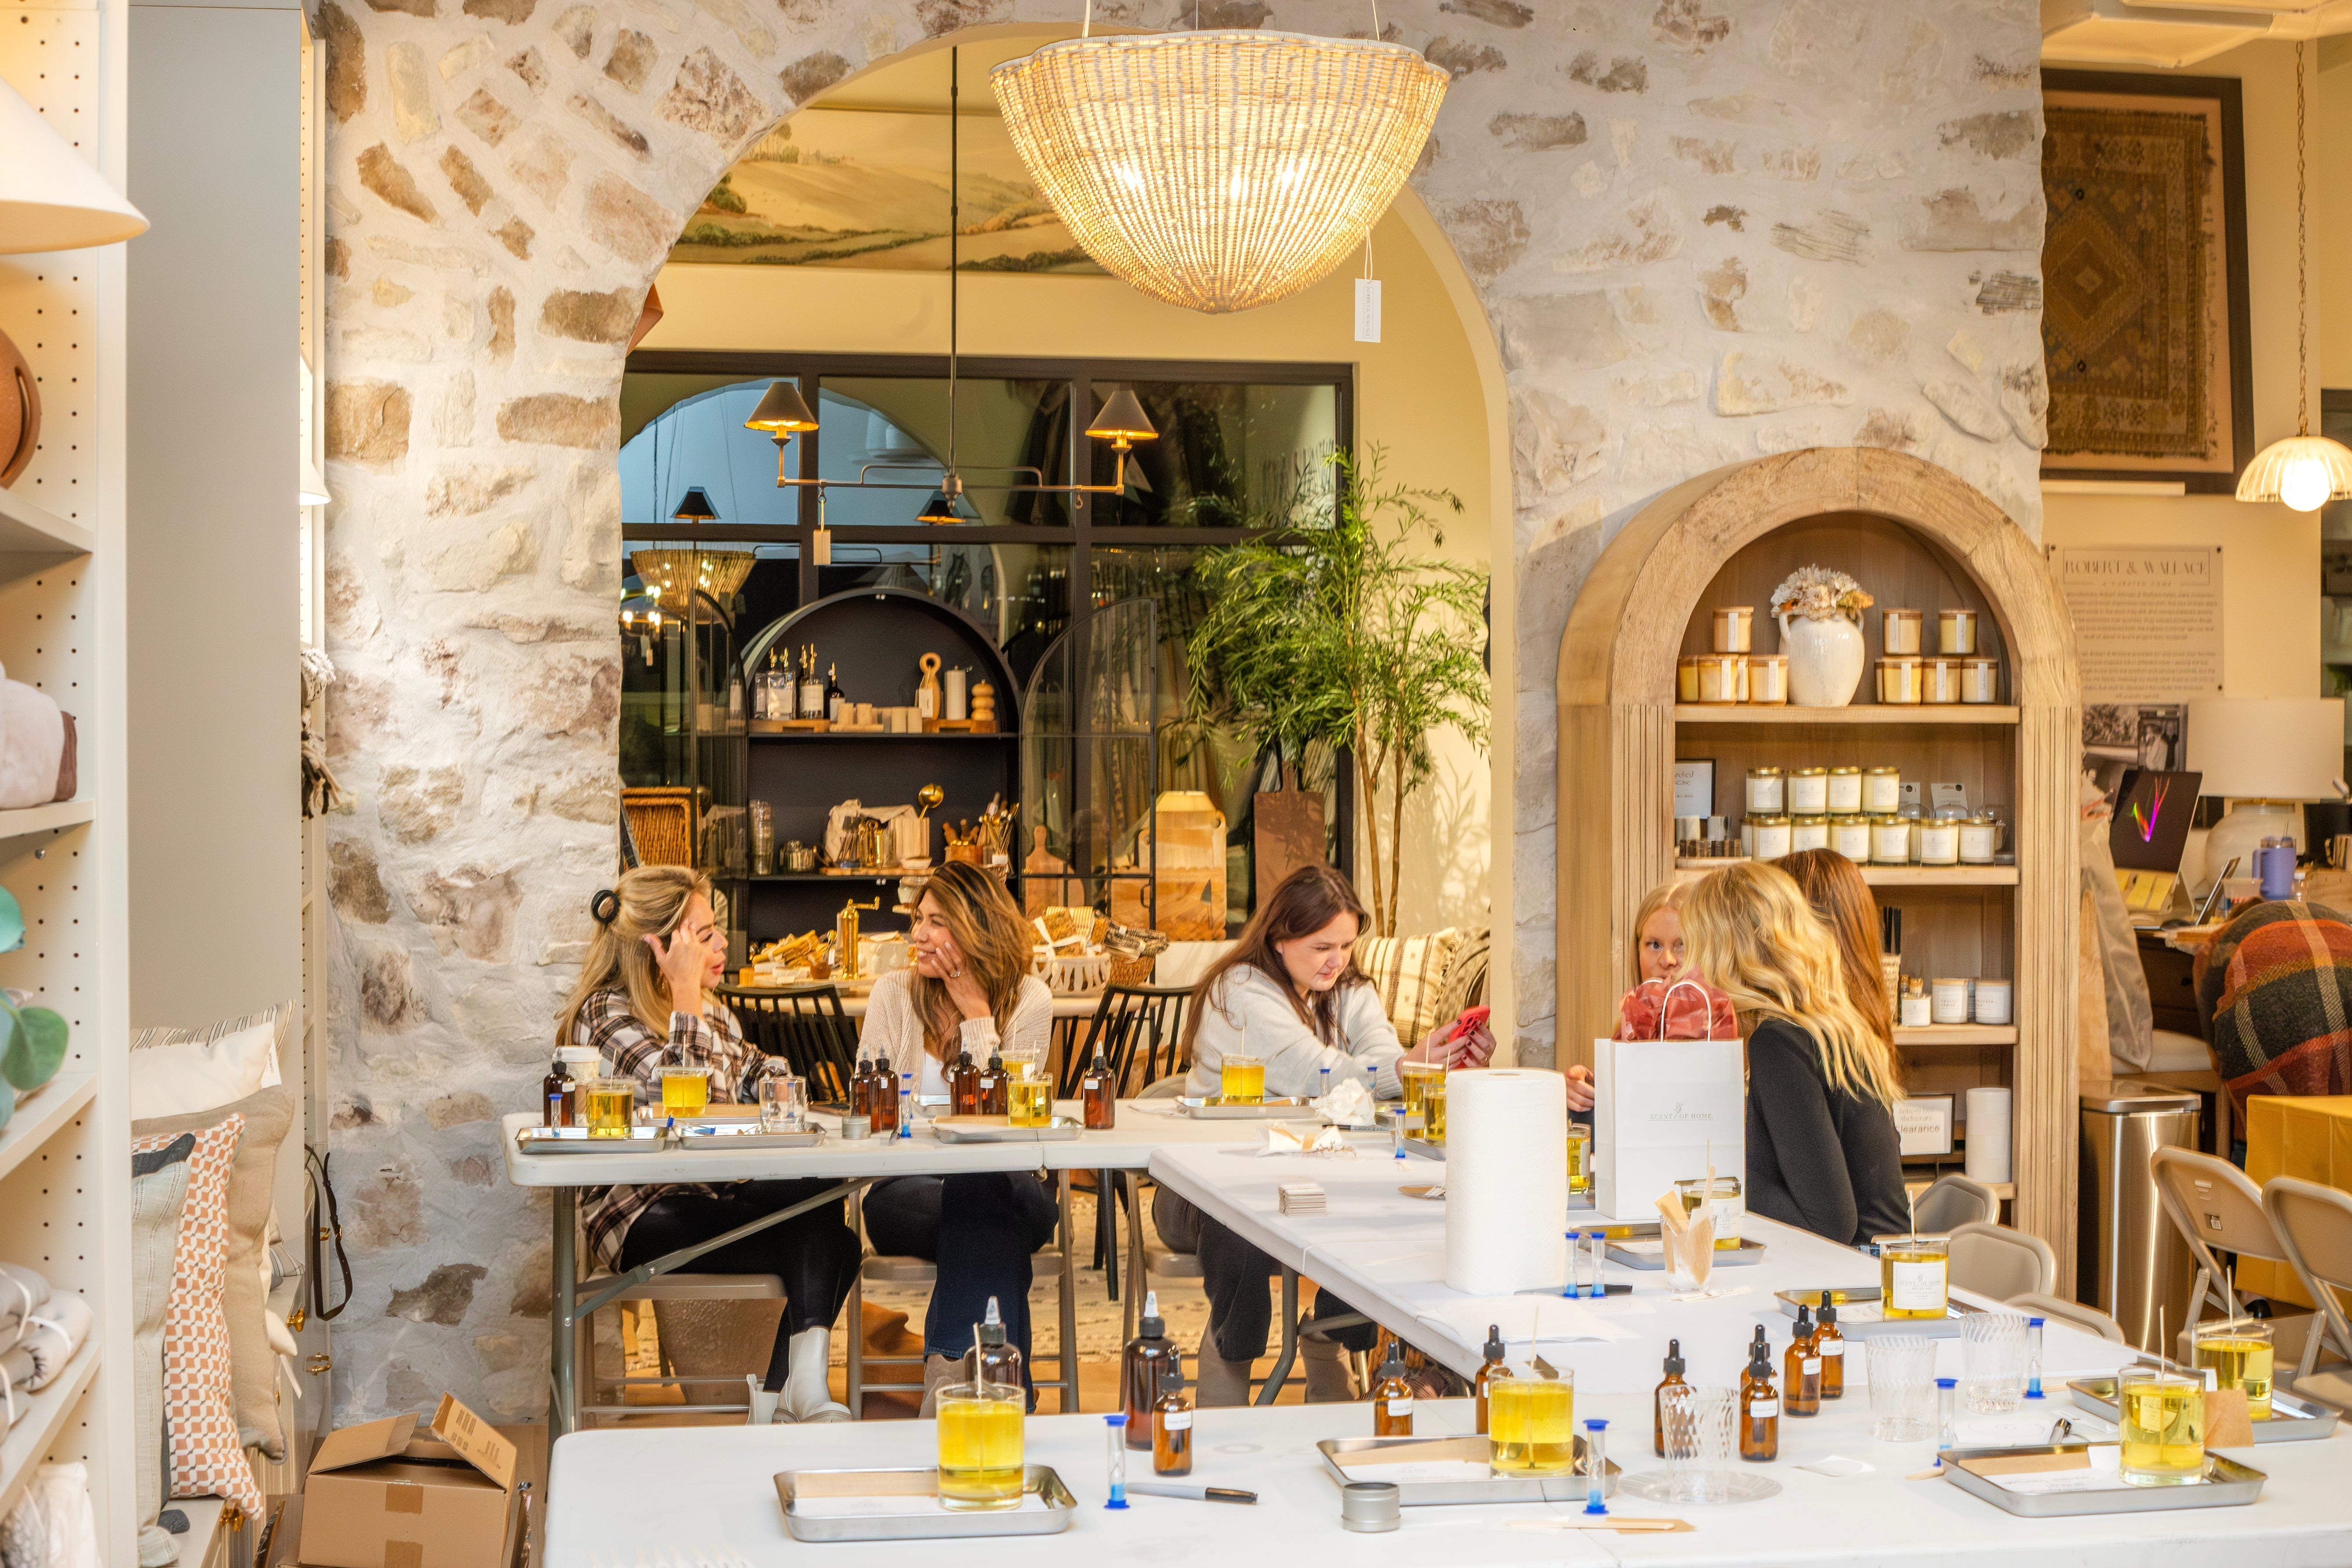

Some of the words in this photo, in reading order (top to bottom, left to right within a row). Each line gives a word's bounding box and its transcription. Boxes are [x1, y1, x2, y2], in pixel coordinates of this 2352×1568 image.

[2065, 560, 2123, 574] ROBERT
[2126, 561, 2137, 575] &
[2144, 561, 2207, 575] WALLACE
